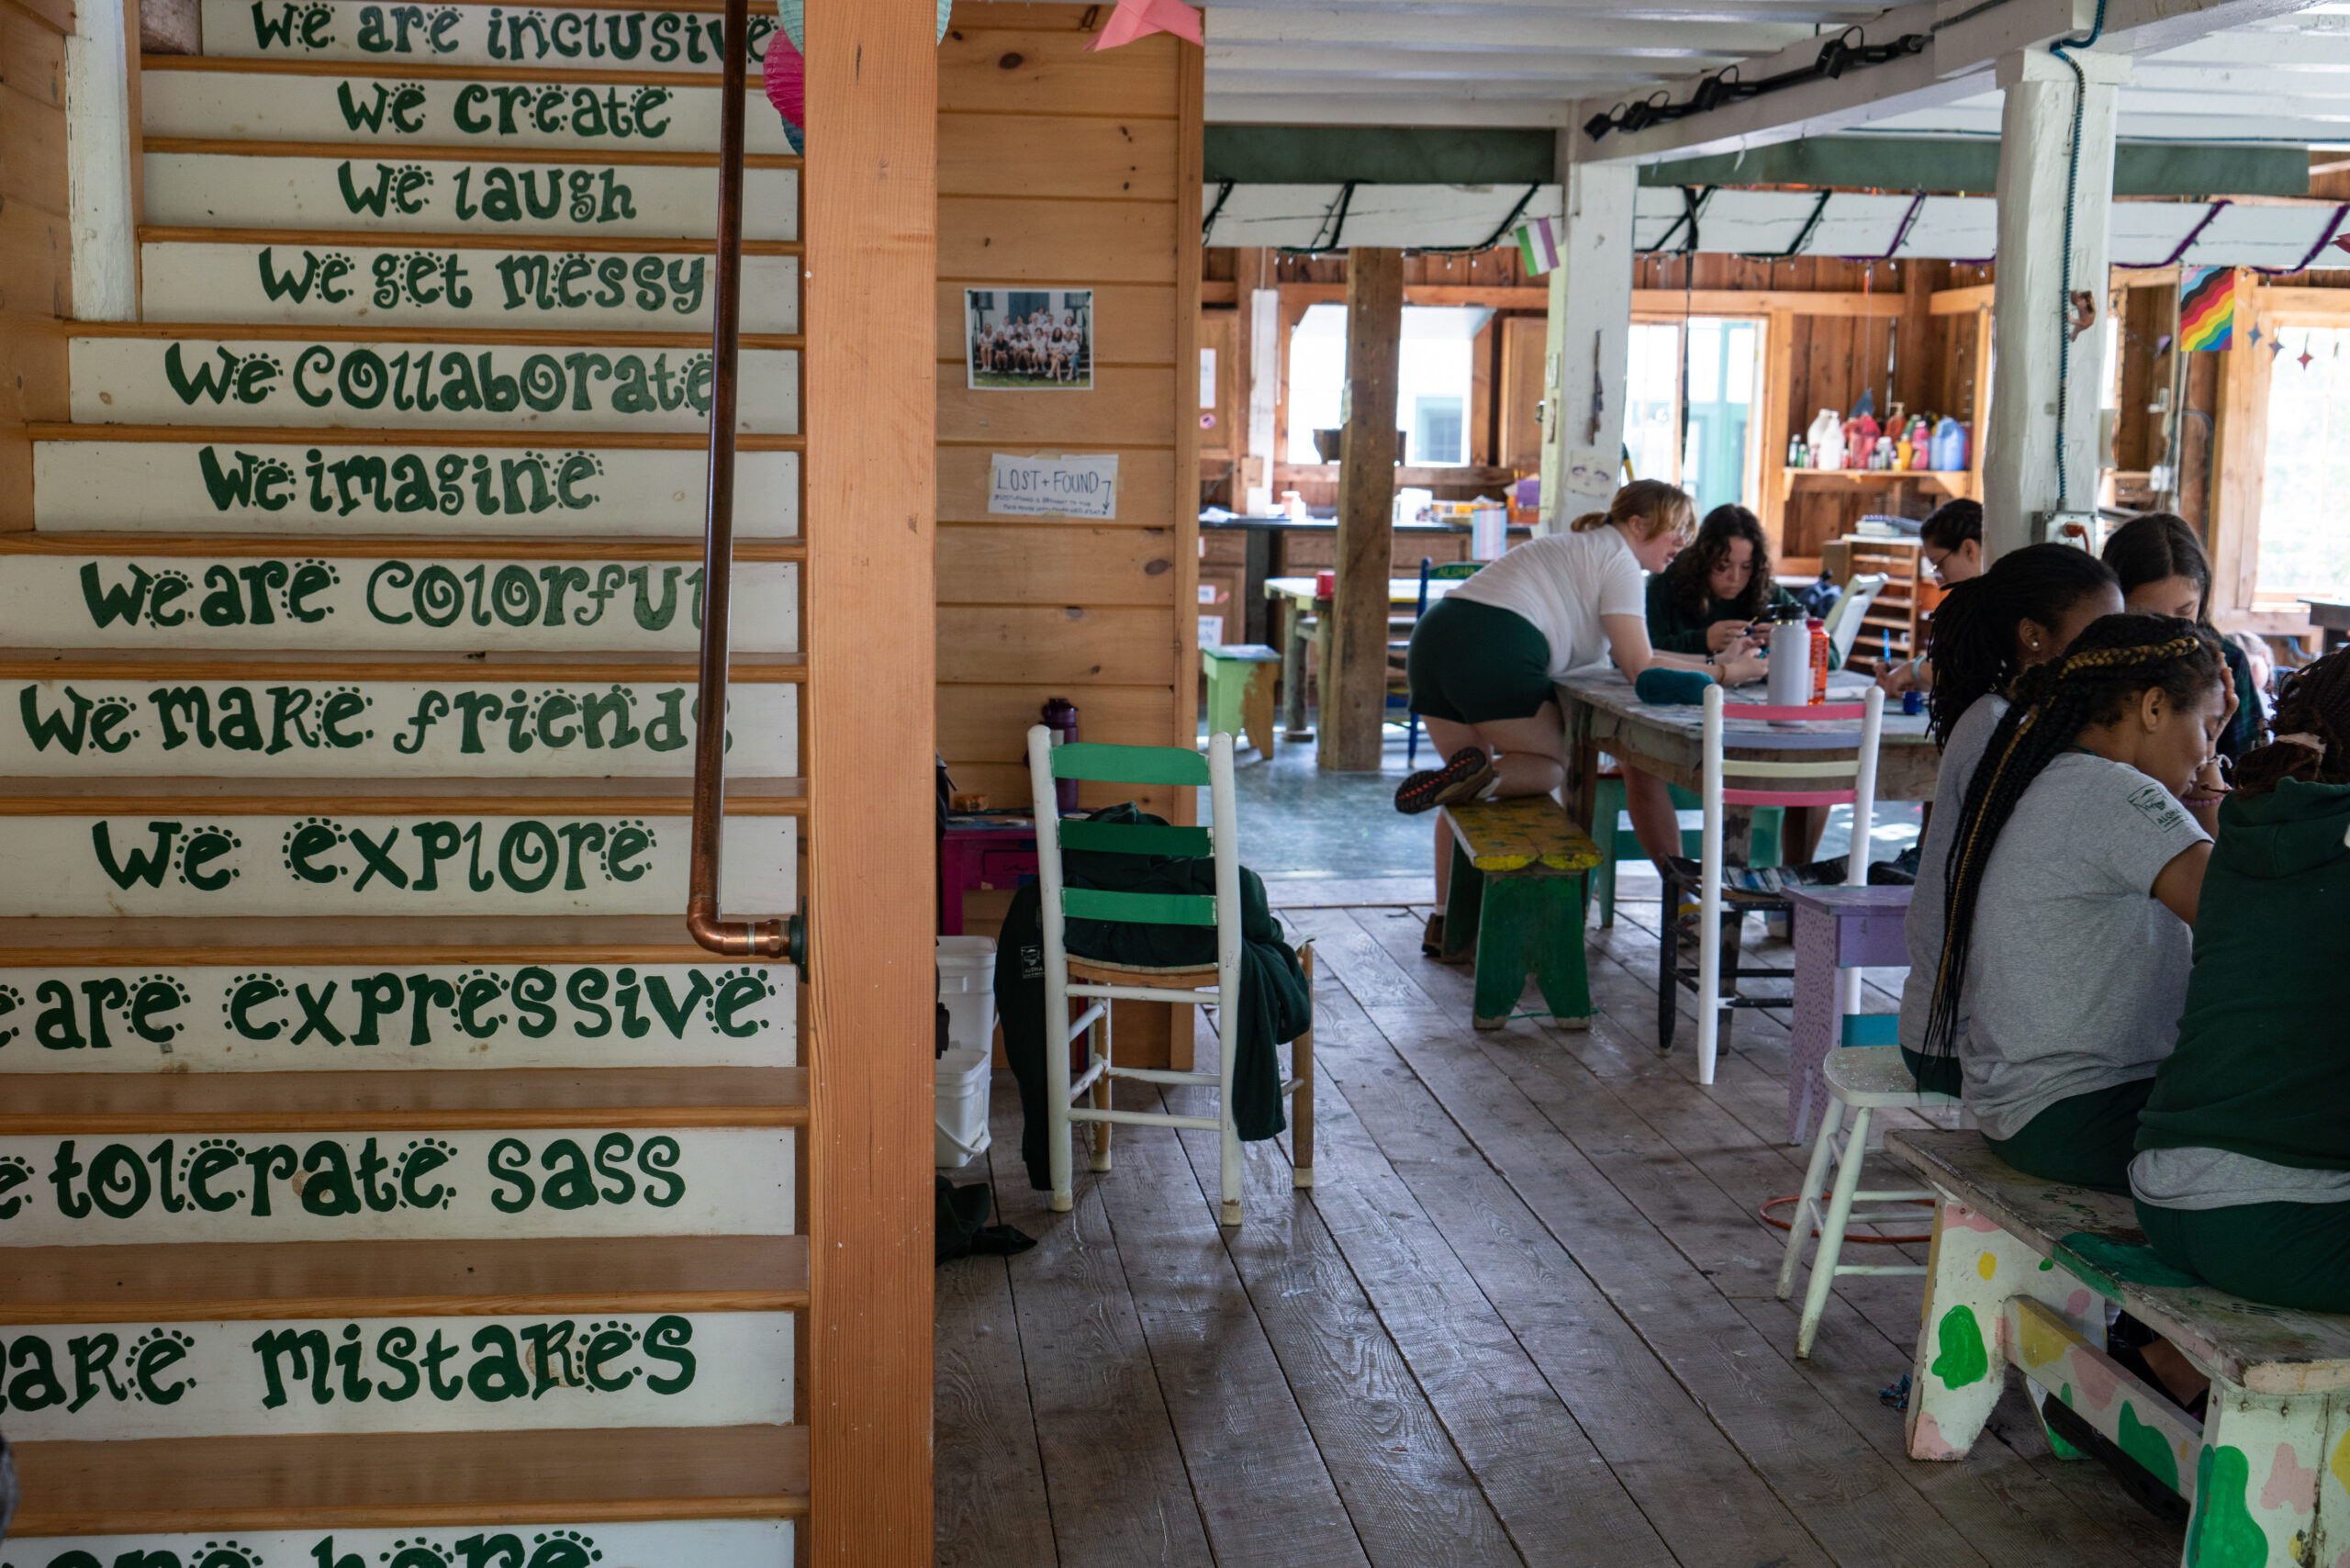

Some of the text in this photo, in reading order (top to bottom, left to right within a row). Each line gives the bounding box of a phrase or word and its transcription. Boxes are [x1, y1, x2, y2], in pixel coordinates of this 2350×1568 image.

[251, 1, 335, 50] We
[357, 6, 463, 54] are
[337, 82, 674, 140] We create
[337, 161, 637, 224] We laugh
[258, 248, 705, 315] We get messy
[164, 342, 284, 406] We
[197, 446, 602, 517] We imagine
[997, 468, 1042, 492] LOST
[1053, 470, 1100, 494] FOUND
[79, 562, 196, 630] We
[199, 559, 341, 628] are
[19, 685, 140, 756] We
[92, 817, 658, 894] We explore
[35, 974, 191, 1049] are
[221, 967, 776, 1047] expressive
[48, 1138, 458, 1220] tolerate
[487, 1133, 687, 1215] sass
[0, 1327, 196, 1415] ake
